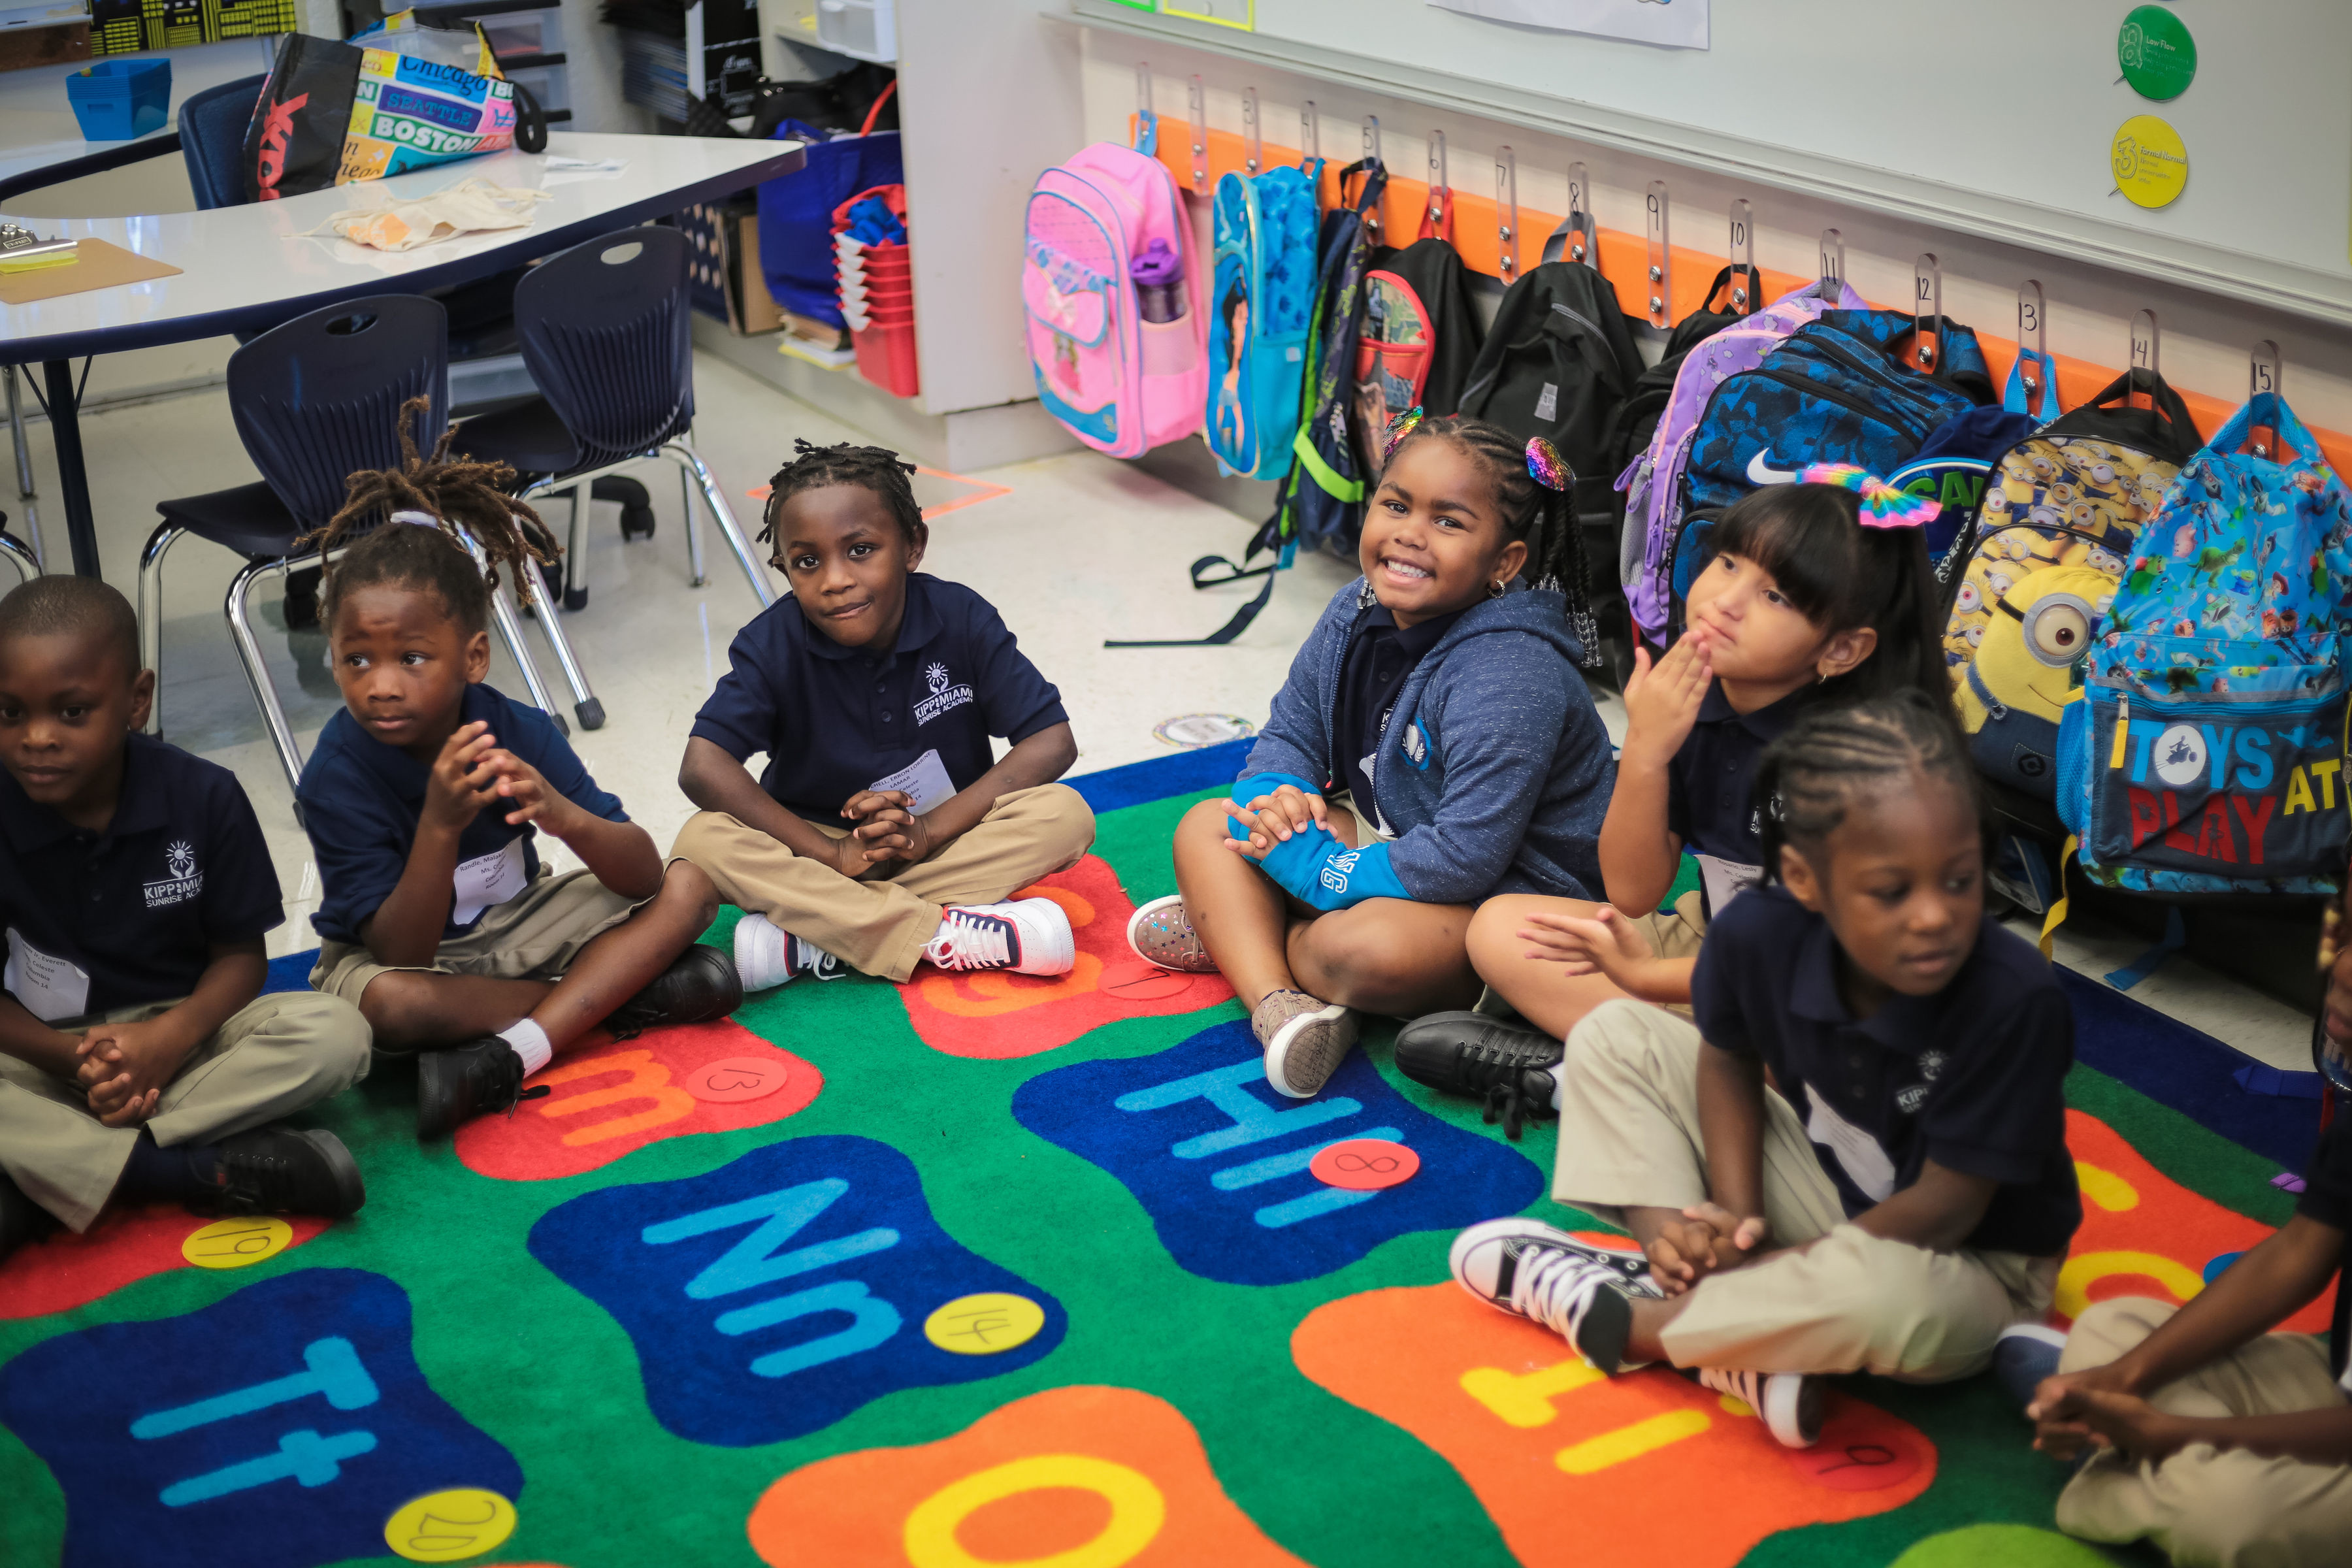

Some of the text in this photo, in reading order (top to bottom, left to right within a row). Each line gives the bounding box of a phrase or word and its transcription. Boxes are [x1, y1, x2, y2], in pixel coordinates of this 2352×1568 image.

[2146, 35, 2176, 52] Low Flow
[387, 93, 473, 127] SEATTLE
[374, 115, 478, 152] BOSTON
[1363, 126, 1374, 150] 5
[1429, 142, 1440, 170] 6
[2115, 136, 2138, 179] 3
[2140, 146, 2187, 165] Formal Normal
[1495, 163, 1506, 187] 7
[1570, 182, 1580, 216] 8
[1646, 193, 1659, 231] 9
[1730, 221, 1745, 248] 10
[1823, 252, 1837, 285] 11
[1917, 276, 1932, 301] 12
[2017, 301, 2038, 332] 13
[2131, 337, 2149, 368] 14
[2251, 361, 2273, 392] 15
[918, 696, 973, 727] SUNRISE ACADEMY
[2129, 719, 2275, 789] TOYS
[890, 769, 910, 781] ERRON
[890, 776, 911, 789] LAMAR
[2283, 758, 2341, 815] AT
[2128, 787, 2278, 864] PLAY
[460, 860, 482, 872] Randle,
[146, 894, 182, 907] SUNRISE
[32, 960, 55, 973] Celeste
[42, 956, 67, 967] Everett
[706, 1068, 765, 1092] 13
[641, 1177, 903, 1379] Nn
[946, 1308, 1012, 1345] 14
[130, 1335, 380, 1507] Tt
[408, 1500, 497, 1552] 20
